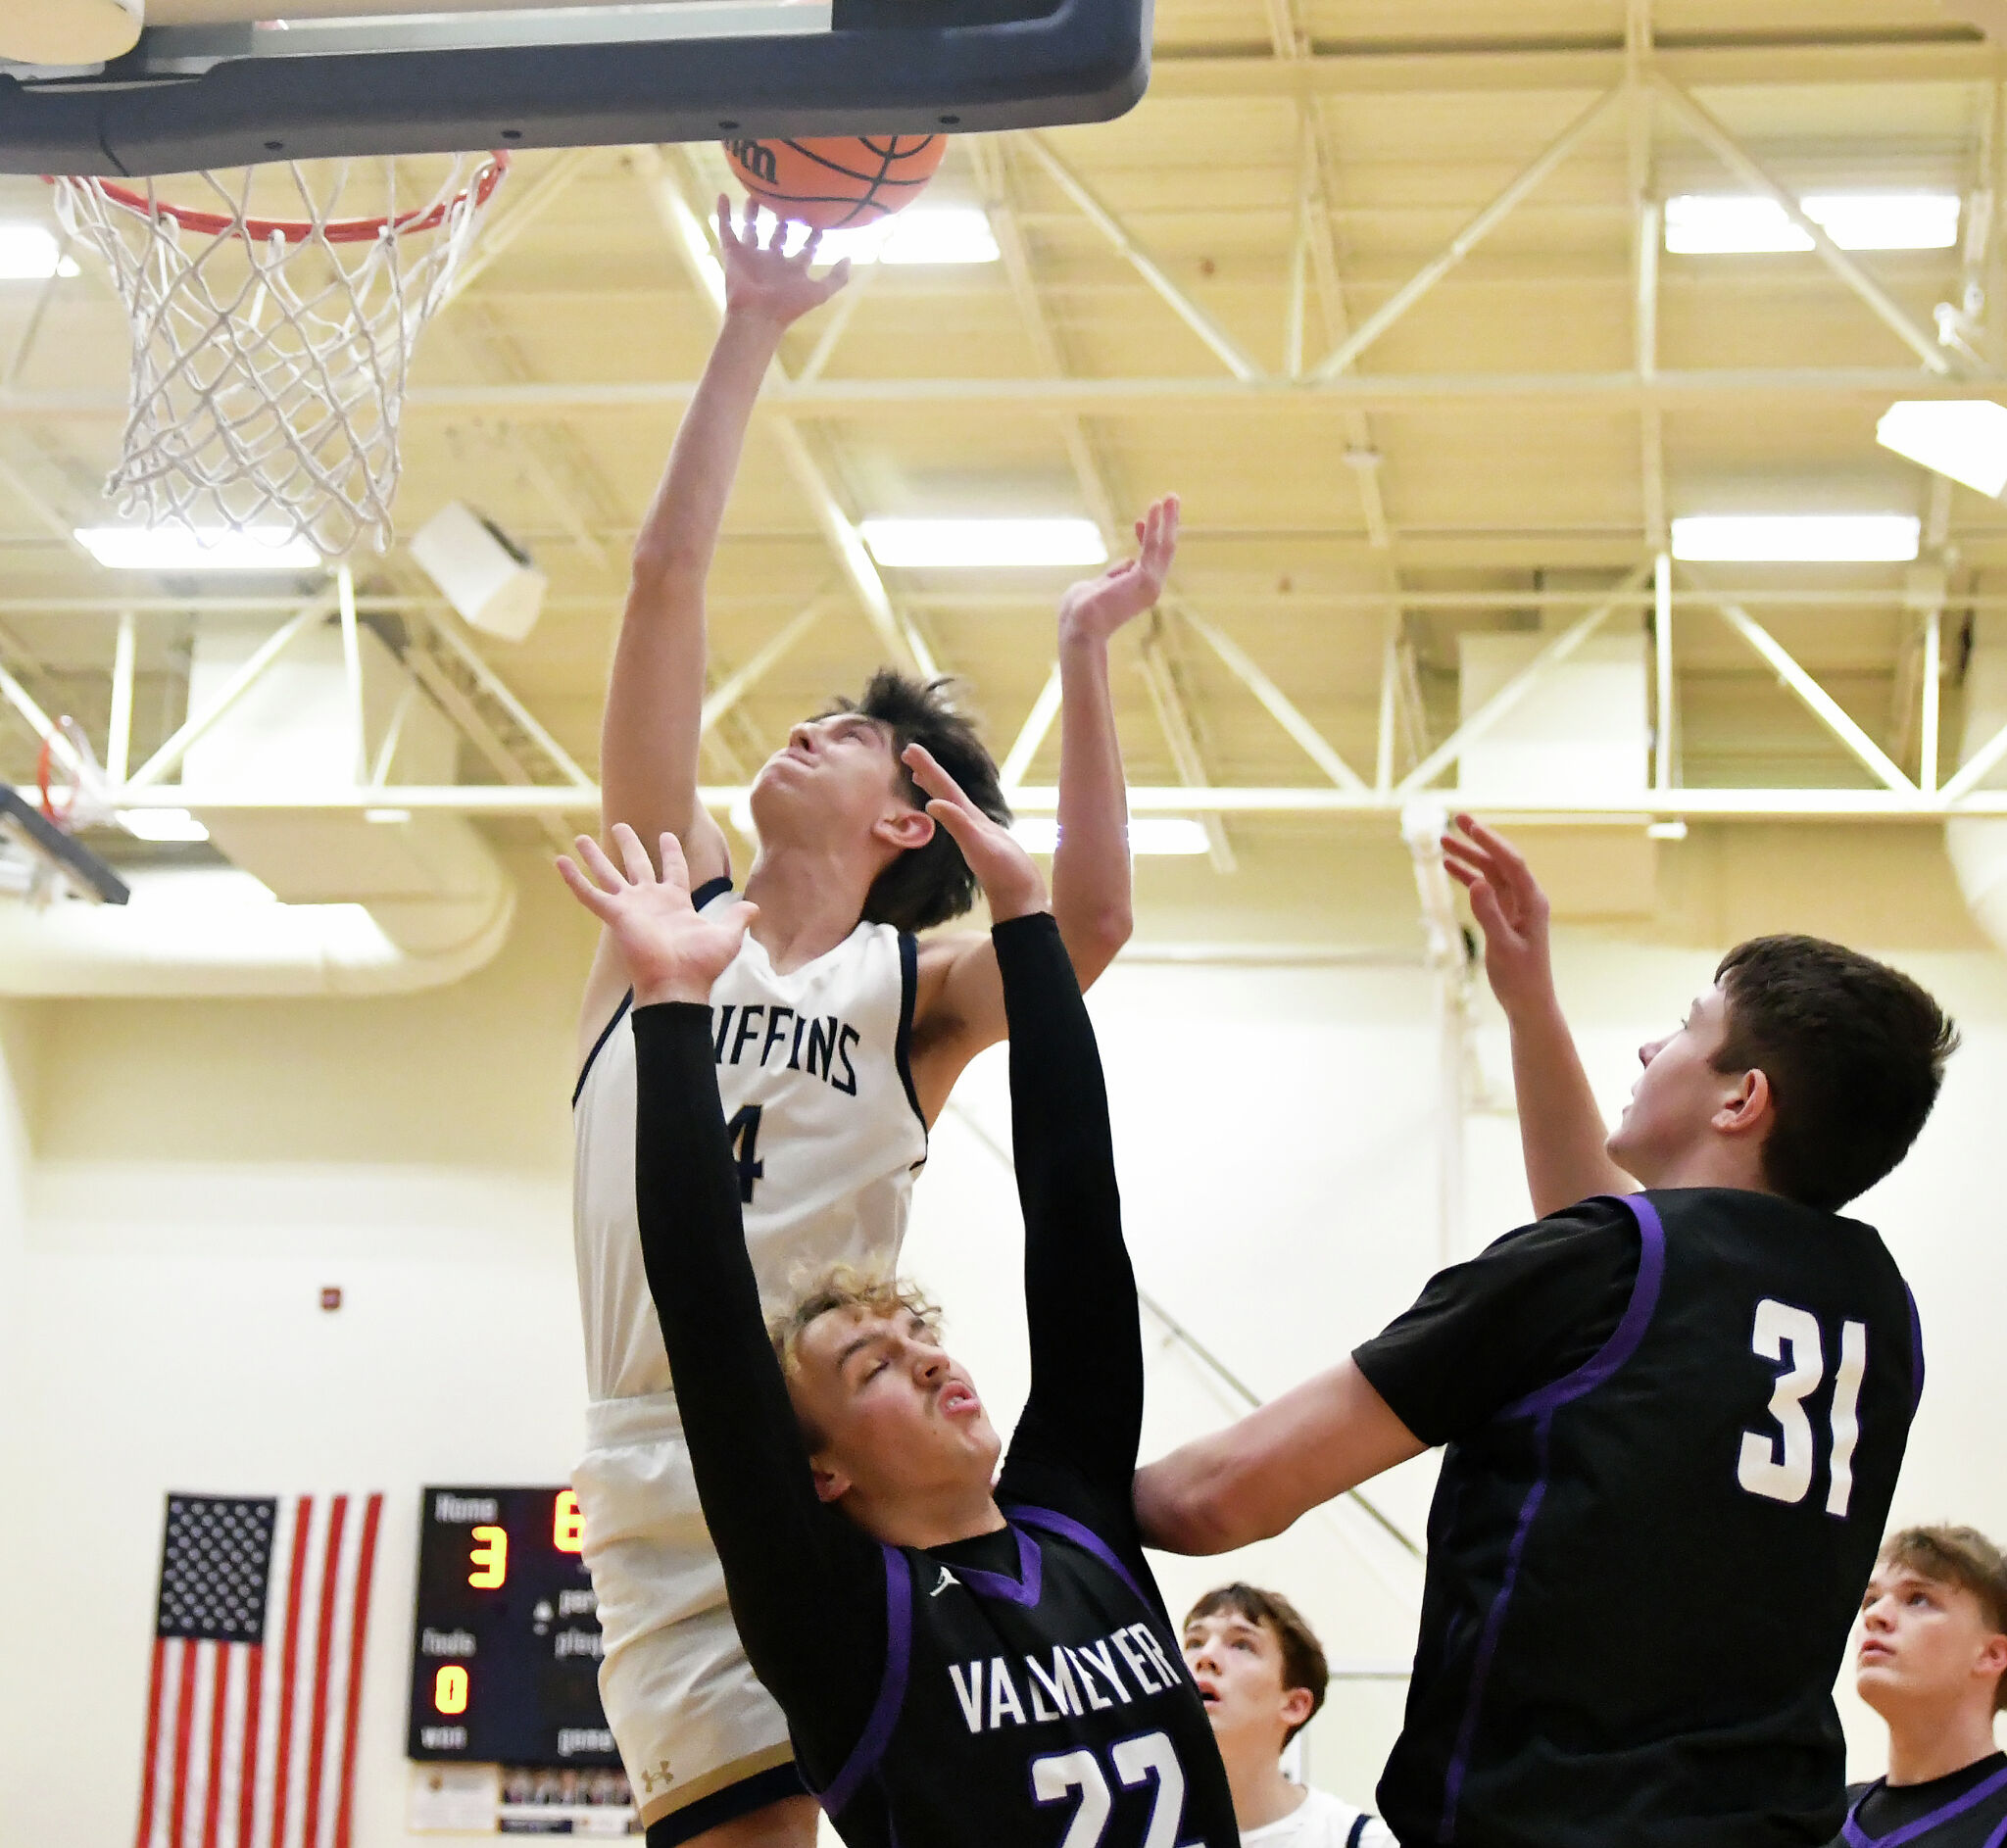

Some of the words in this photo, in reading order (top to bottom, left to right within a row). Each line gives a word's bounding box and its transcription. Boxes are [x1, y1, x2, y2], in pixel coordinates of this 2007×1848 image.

[715, 1004, 859, 1096] IFFINS
[726, 1104, 764, 1204] 4
[1738, 1298, 1865, 1517] 31
[467, 1526, 508, 1588] 3
[435, 1665, 468, 1715] 0
[949, 1623, 1182, 1733] VALMEYER
[1031, 1730, 1206, 1848] 22
